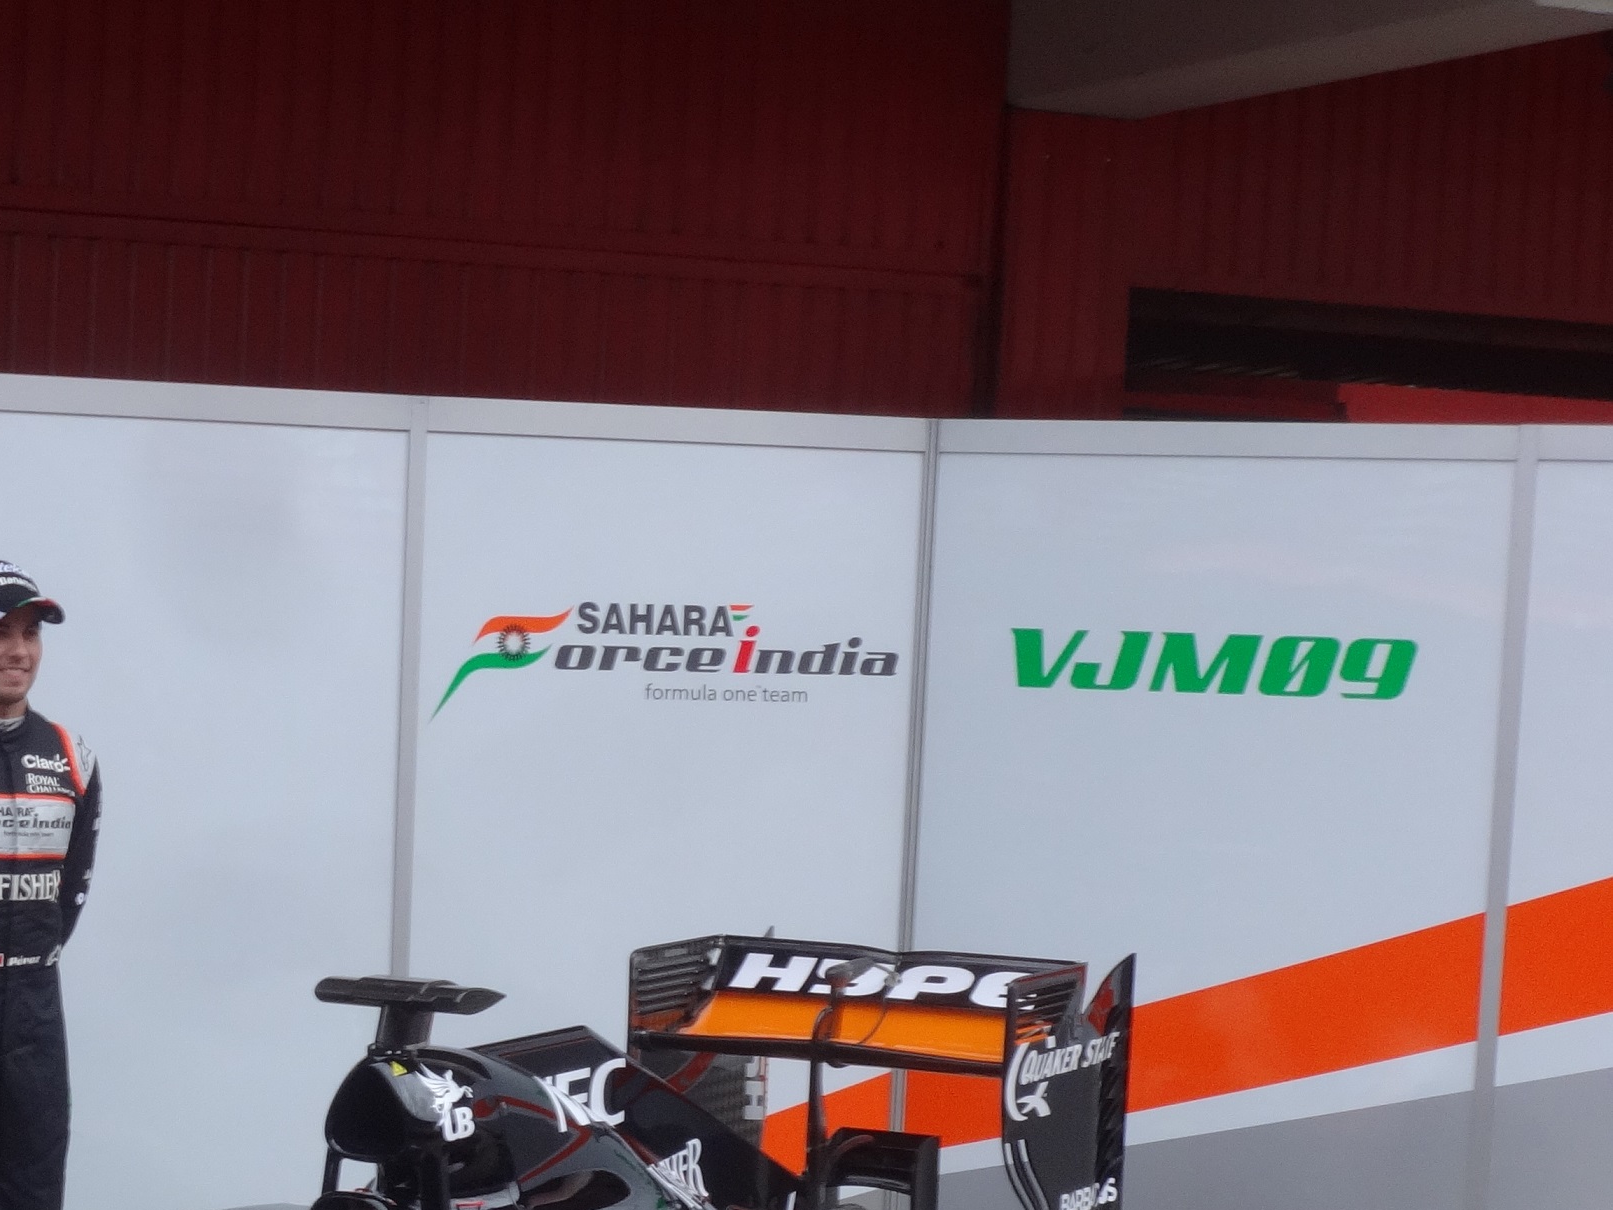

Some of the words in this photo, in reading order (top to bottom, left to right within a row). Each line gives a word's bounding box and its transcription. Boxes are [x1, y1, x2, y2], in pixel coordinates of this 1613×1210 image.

[576, 601, 735, 637] SAHARA
[1010, 627, 1419, 701] VJM09
[645, 683, 718, 702] formula
[723, 688, 758, 702] one
[763, 687, 808, 703] team
[21, 753, 71, 773] Claro
[25, 772, 61, 786] ROYAL
[1018, 1042, 1083, 1086] QUAKER
